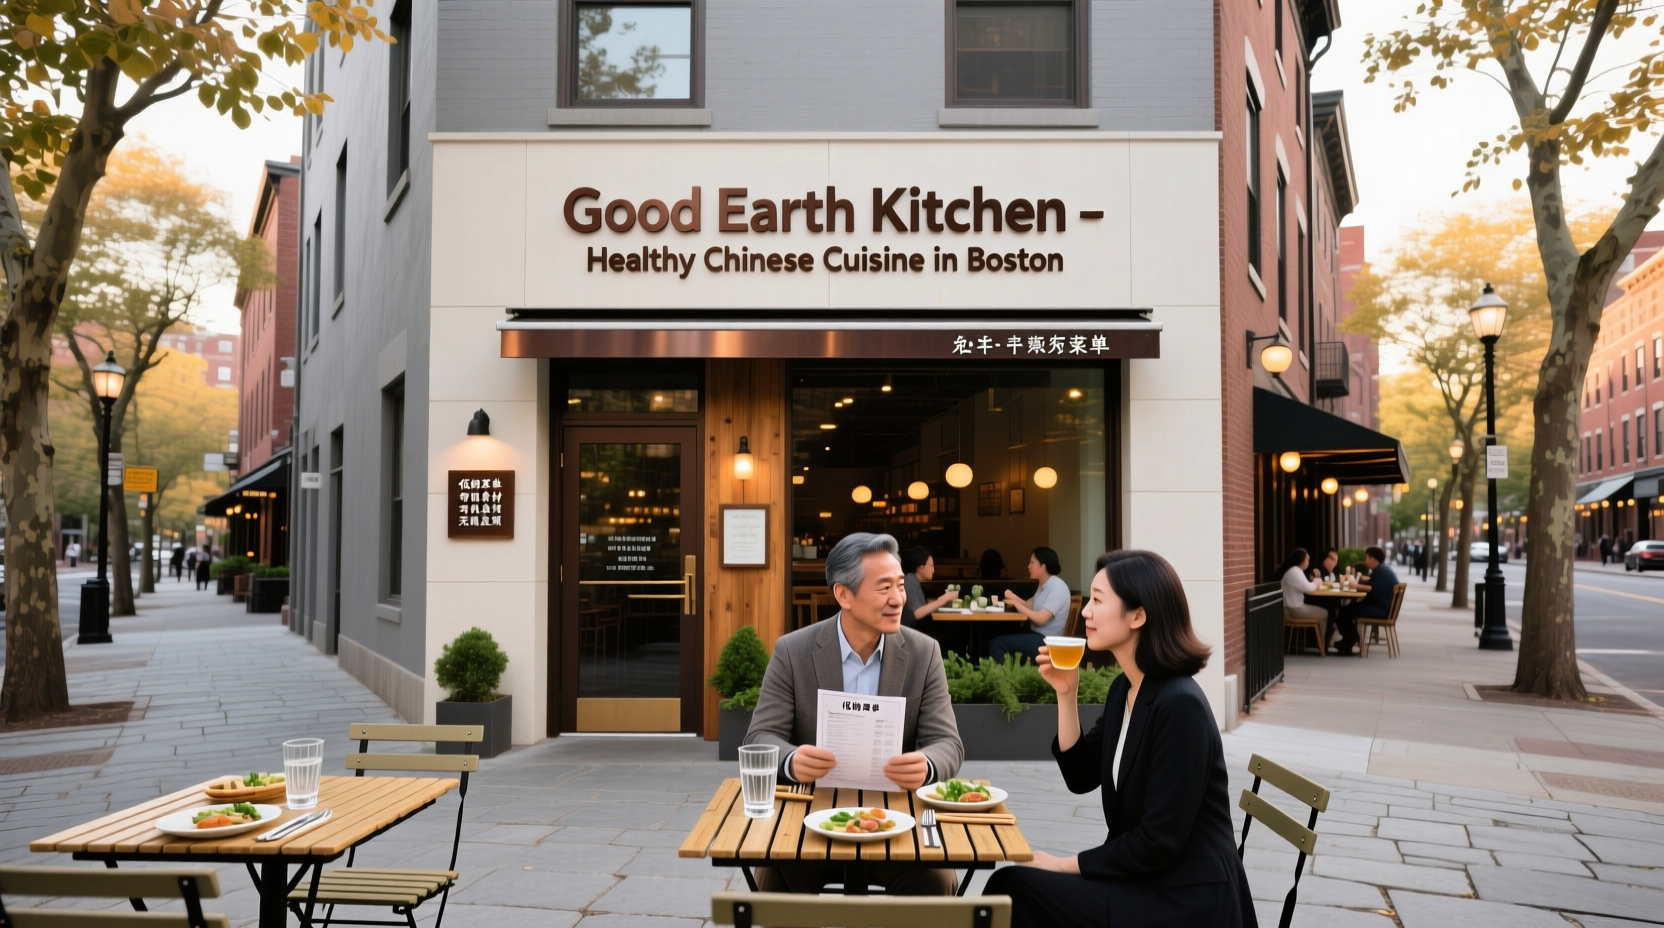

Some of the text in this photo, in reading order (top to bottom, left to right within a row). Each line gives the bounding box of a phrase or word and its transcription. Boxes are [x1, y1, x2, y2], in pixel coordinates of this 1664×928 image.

[563, 186, 702, 236] Good
[718, 185, 855, 236] Earth
[872, 185, 1067, 235] Kitchen
[587, 245, 1064, 280] Healthy Chinese Cuisine in Boston
